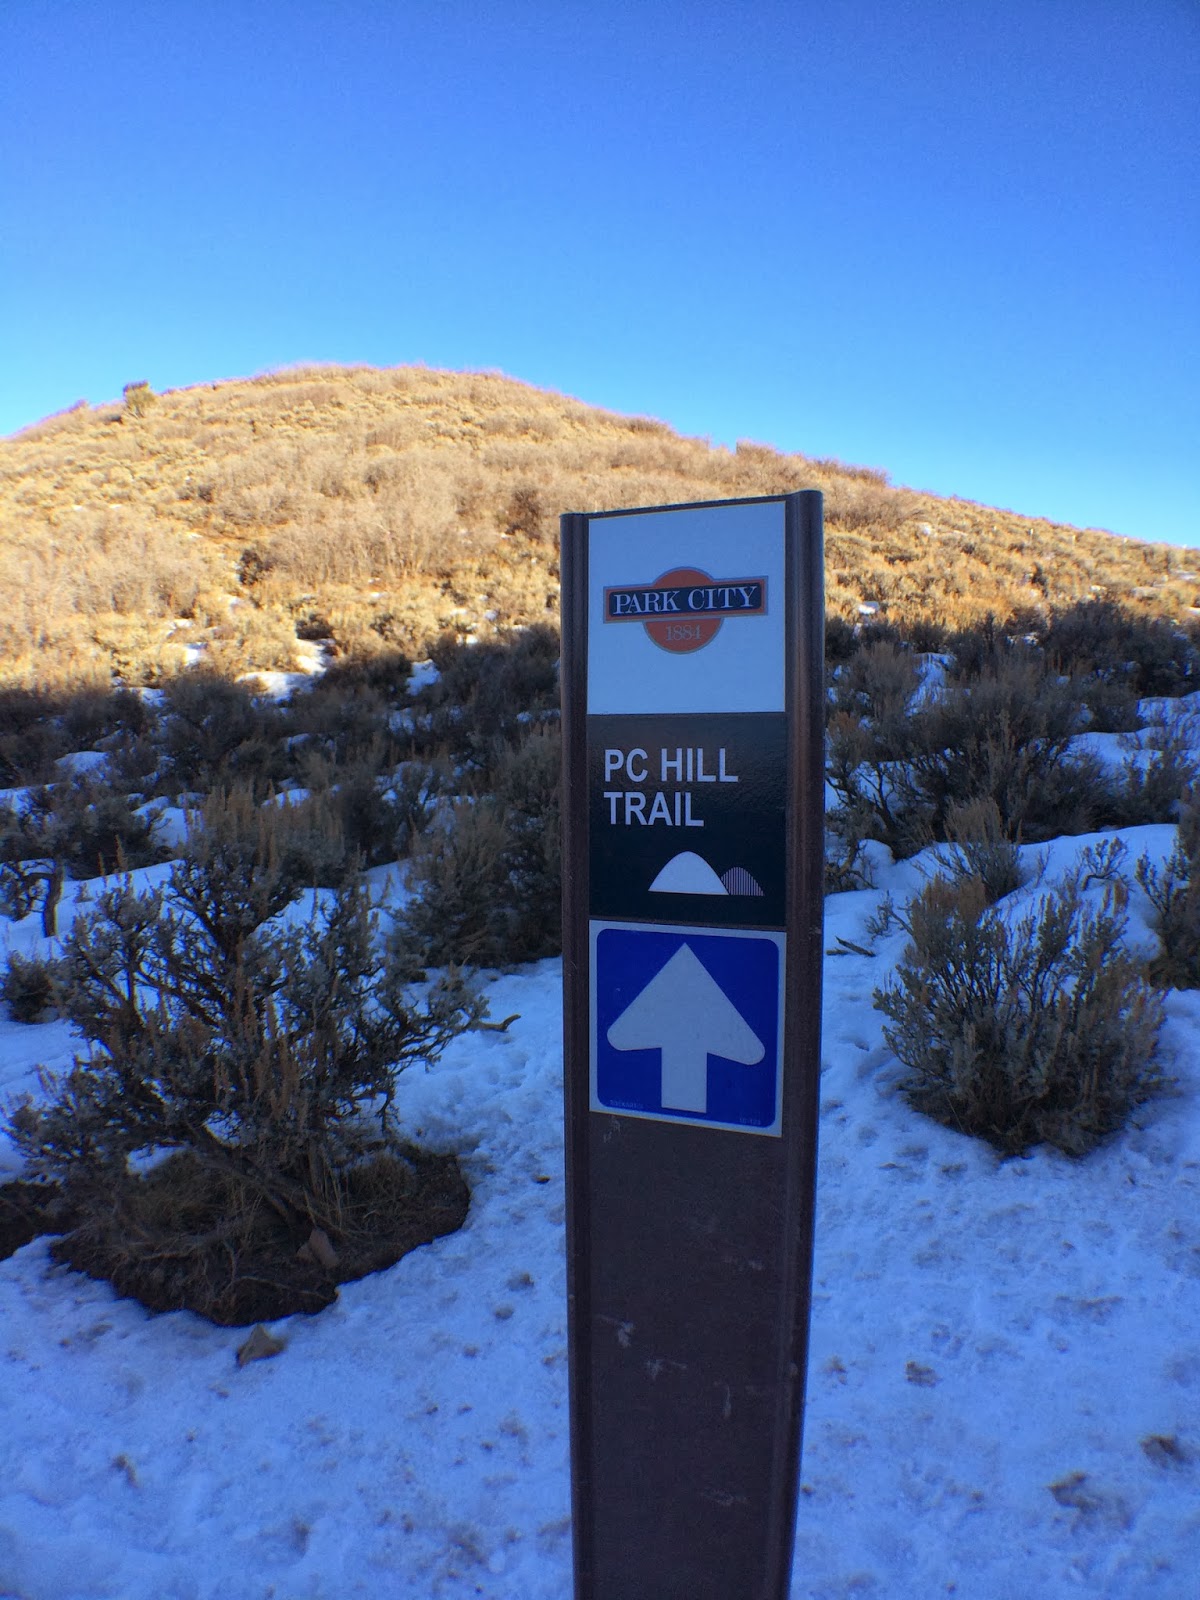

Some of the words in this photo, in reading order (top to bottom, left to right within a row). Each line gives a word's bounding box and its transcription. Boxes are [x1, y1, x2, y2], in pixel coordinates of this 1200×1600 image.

[612, 590, 680, 615] PARK
[688, 585, 758, 611] CITY
[665, 624, 701, 641] 1884
[604, 748, 649, 783] PC
[661, 747, 739, 783] HILL
[603, 791, 705, 827] TRAIL
